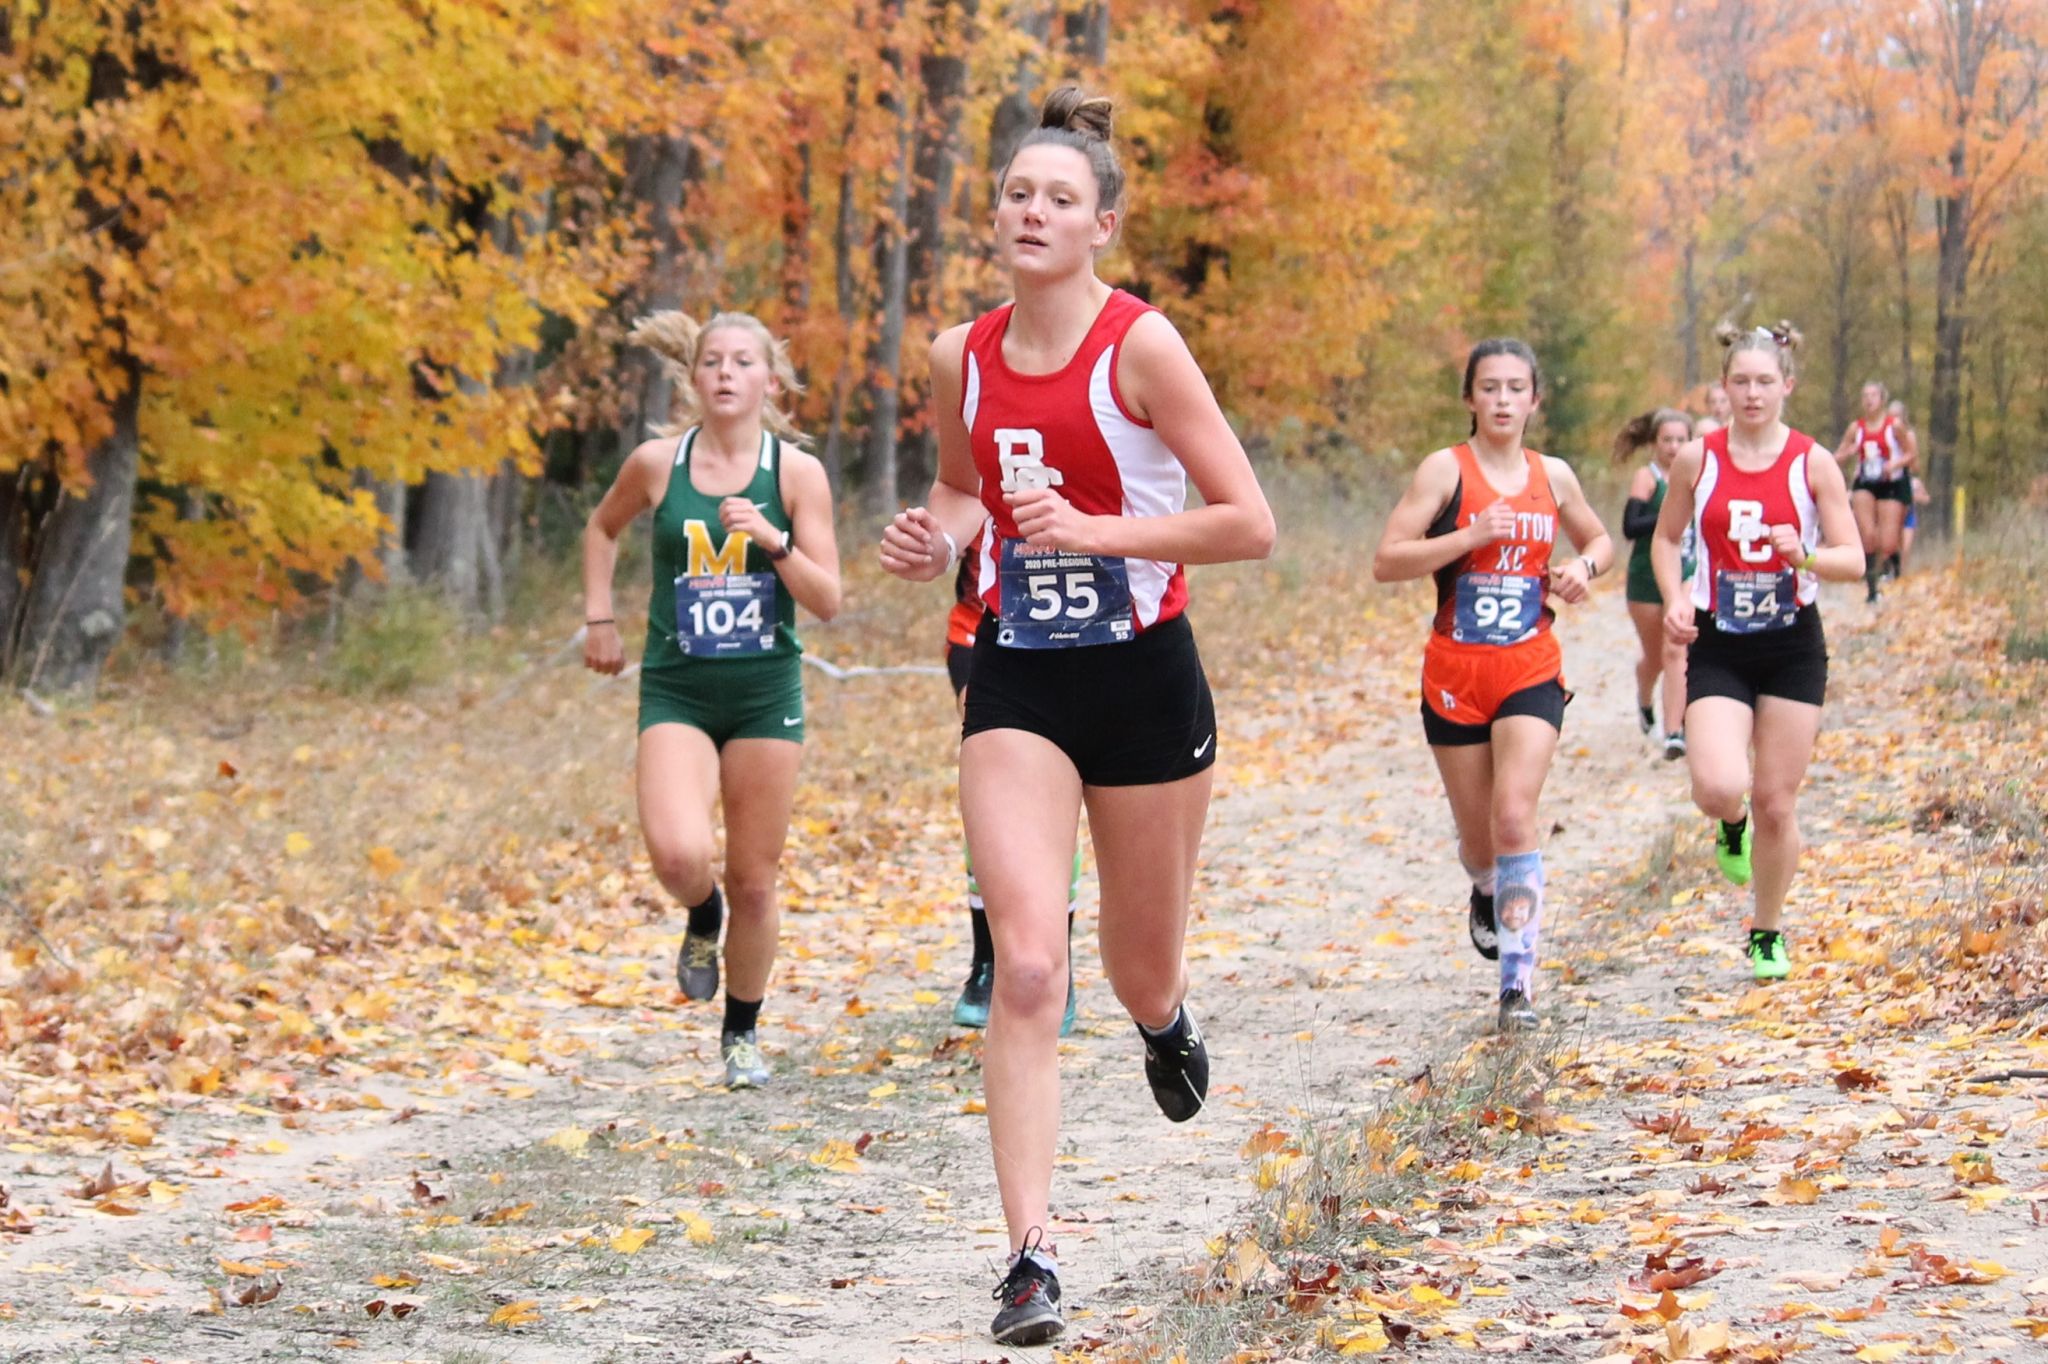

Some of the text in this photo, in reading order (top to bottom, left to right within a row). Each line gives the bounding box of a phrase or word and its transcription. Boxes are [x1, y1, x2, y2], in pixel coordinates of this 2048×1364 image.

[683, 519, 753, 577] M
[1728, 500, 1773, 563] BC
[1024, 557, 1093, 569] 2020 PRE-REGIONAL
[1495, 545, 1527, 571] XC
[1028, 573, 1099, 621] 55
[1474, 596, 1522, 629] 92
[1734, 591, 1780, 618] 54
[689, 599, 763, 636] 104
[1116, 631, 1129, 640] 55
